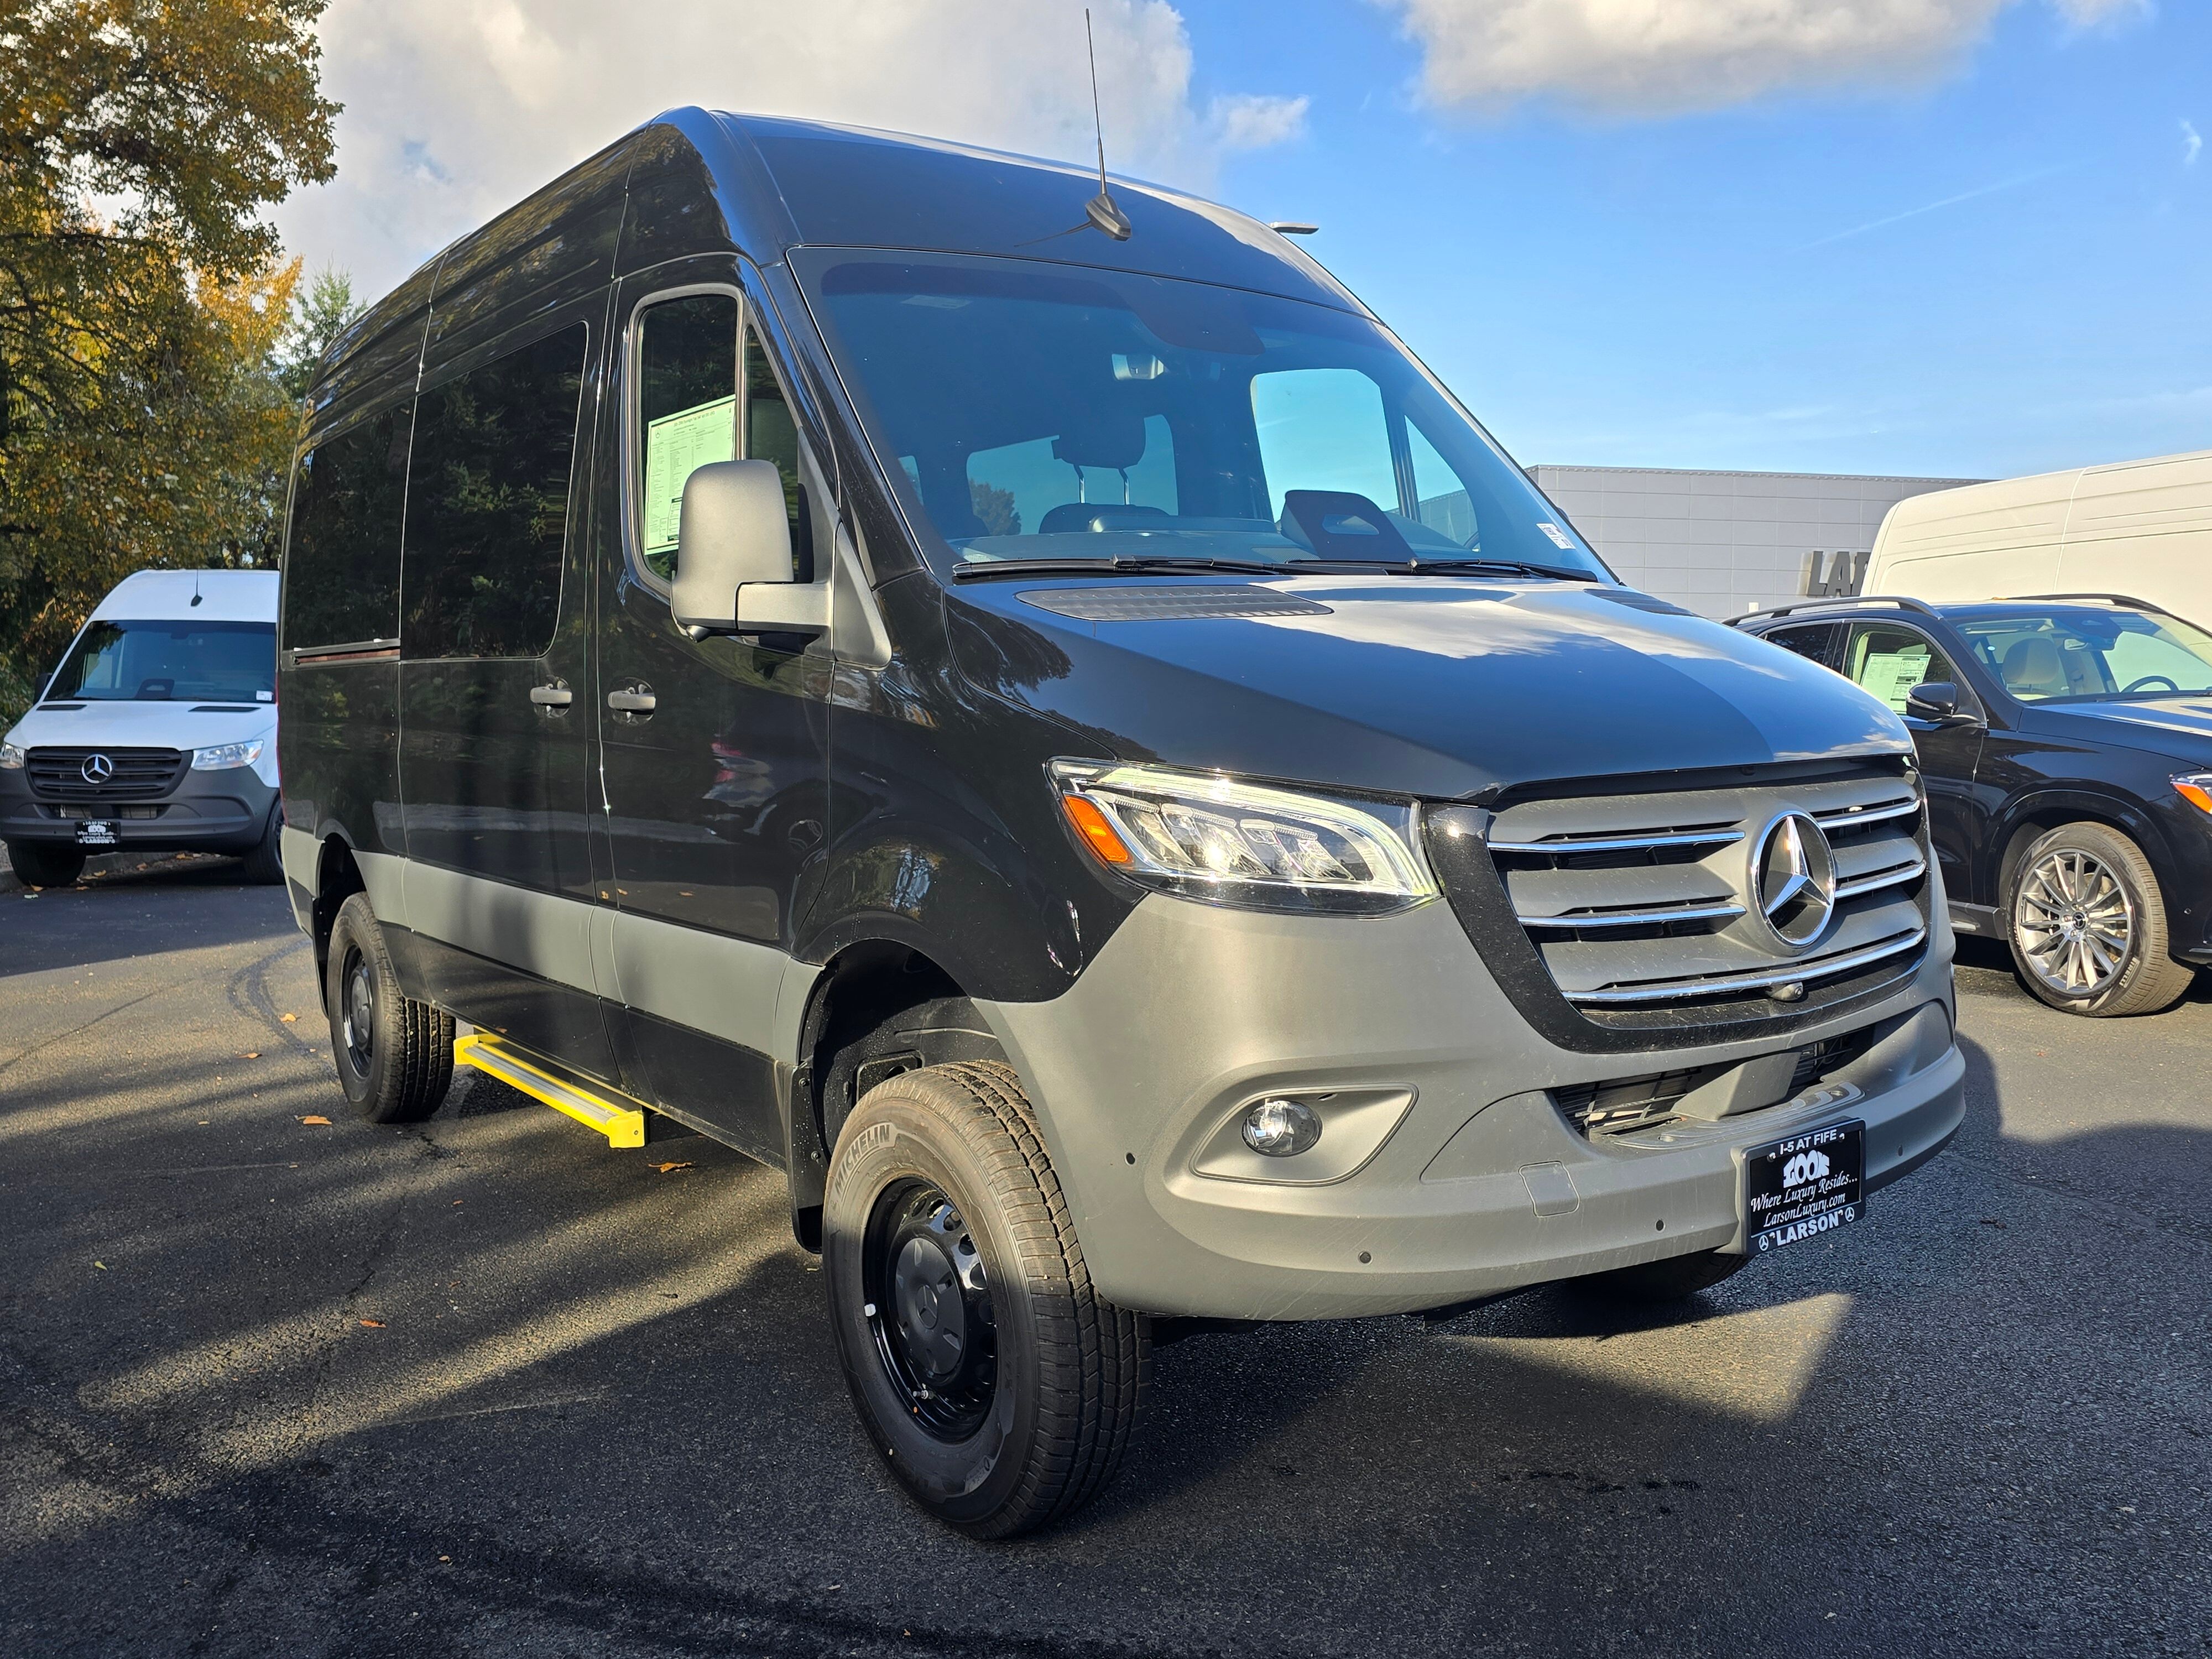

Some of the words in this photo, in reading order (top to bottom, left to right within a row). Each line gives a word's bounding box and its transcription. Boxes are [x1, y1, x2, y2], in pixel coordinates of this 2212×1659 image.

[1780, 1141, 1794, 1155] I-5
[1796, 1136, 1812, 1150] AT
[1814, 1129, 1837, 1145] FIFE
[834, 1124, 890, 1197] MICHELIN
[1751, 1193, 1781, 1212] Where
[1783, 1185, 1817, 1202] Luxury
[1818, 1171, 1858, 1193] Resides...
[1763, 1193, 1845, 1228] LarsonLuxury.com
[1777, 1212, 1839, 1246] LARSON
